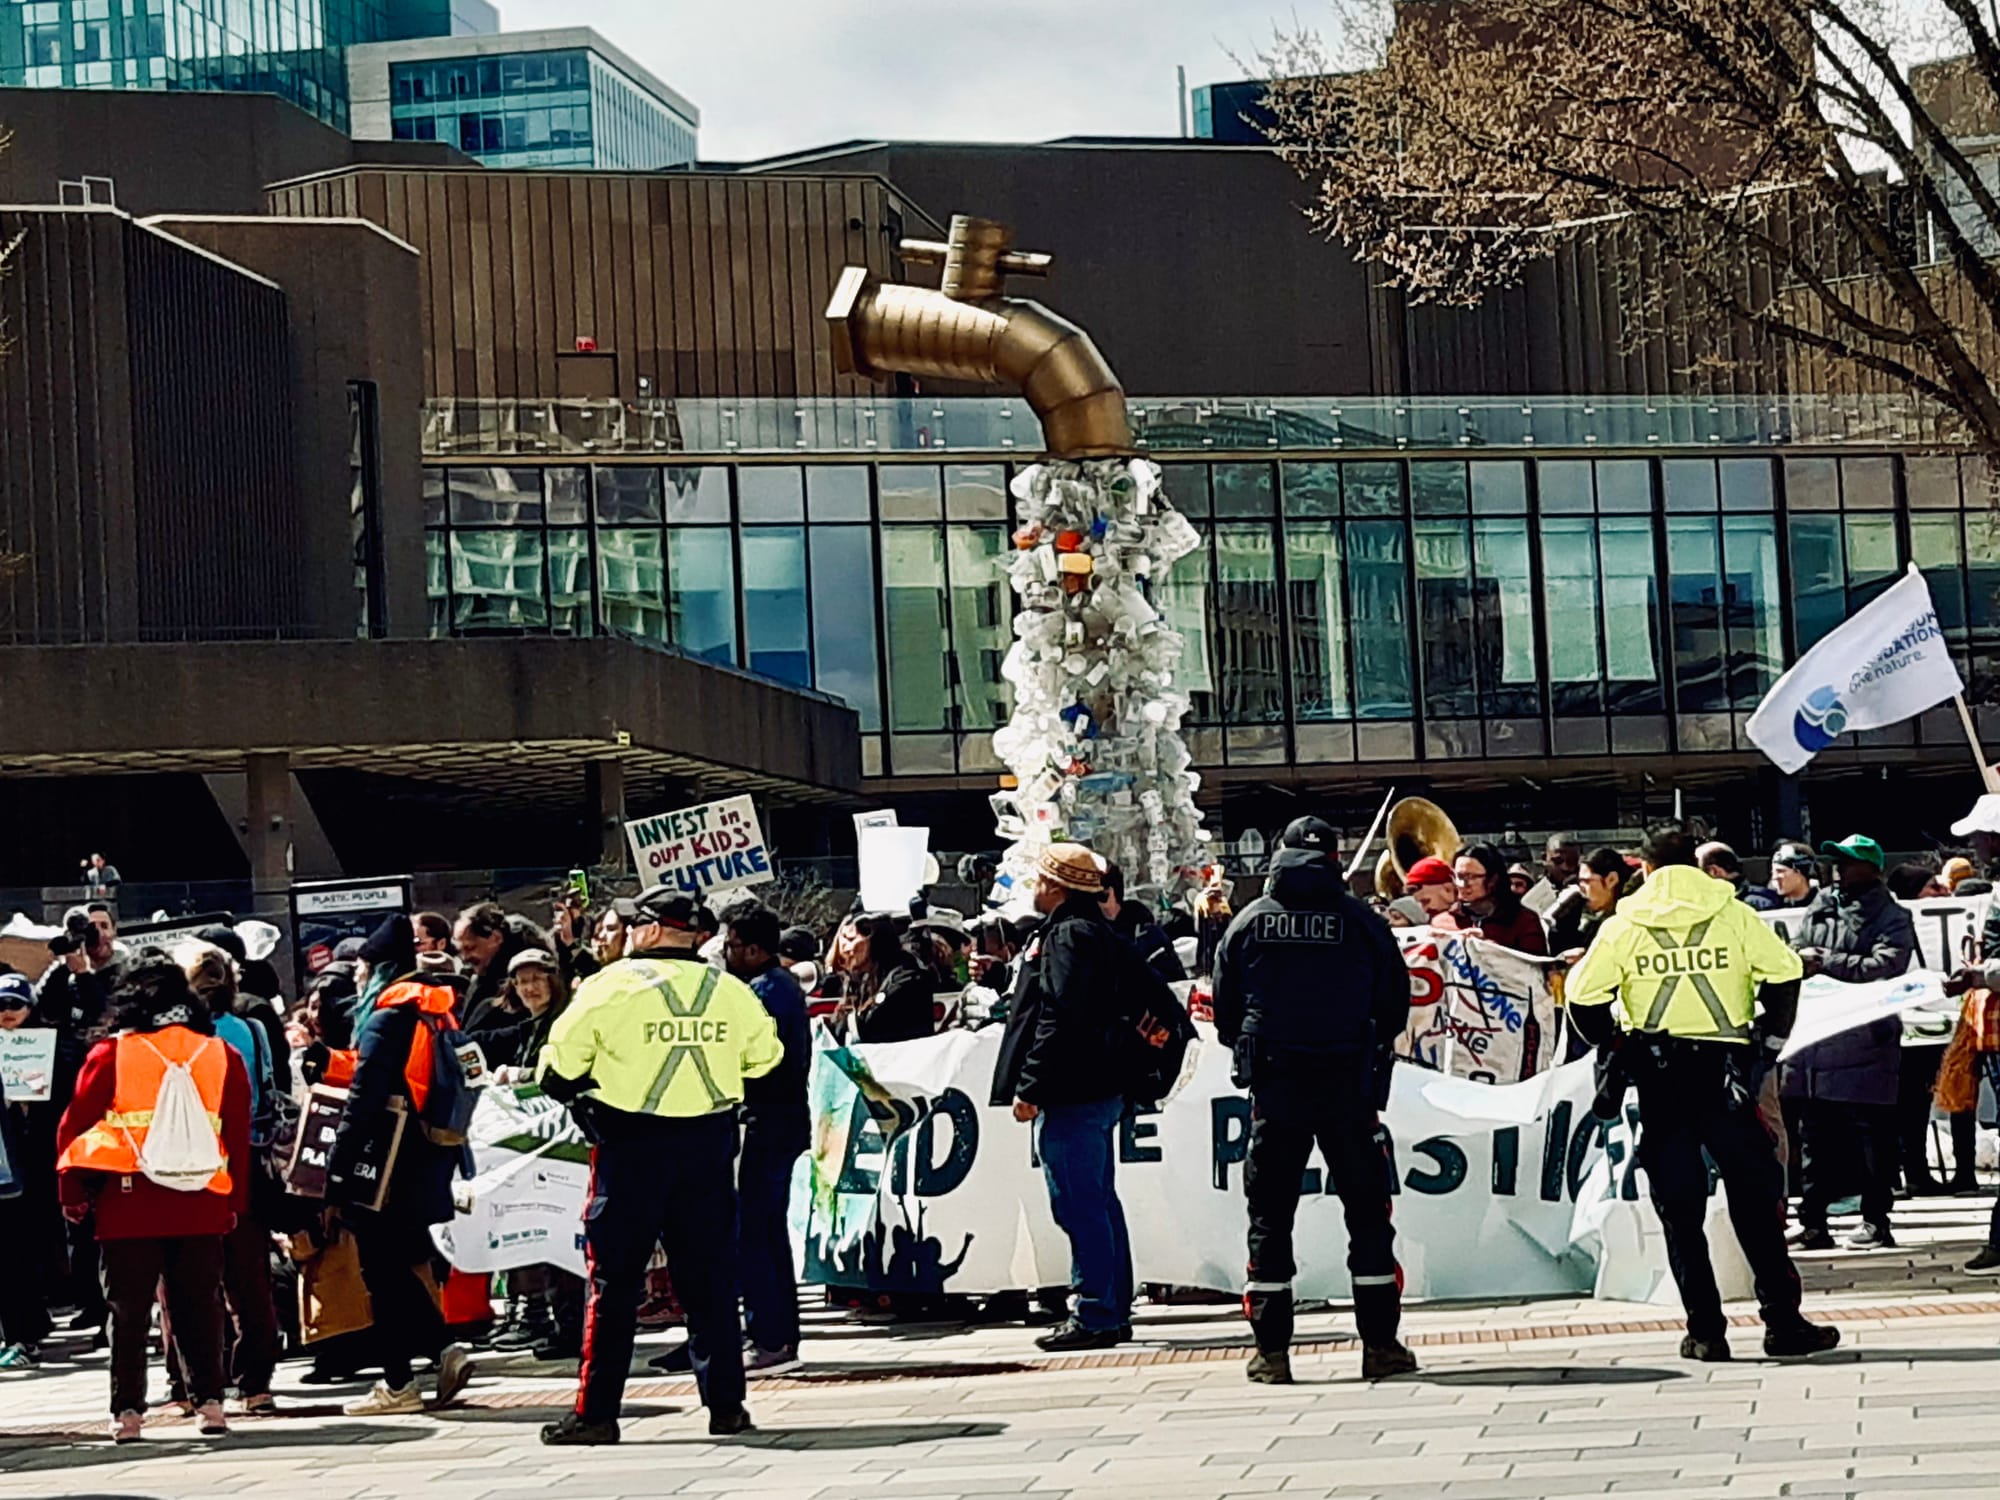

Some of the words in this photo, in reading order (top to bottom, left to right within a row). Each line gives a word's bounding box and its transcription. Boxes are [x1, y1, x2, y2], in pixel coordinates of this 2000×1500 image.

[633, 806, 709, 849] INVEST
[719, 807, 740, 826] in
[659, 845, 769, 892] FUTURE
[1263, 913, 1337, 940] POLICE
[1635, 946, 1729, 976] POLICE
[643, 1020, 728, 1044] POLICE
